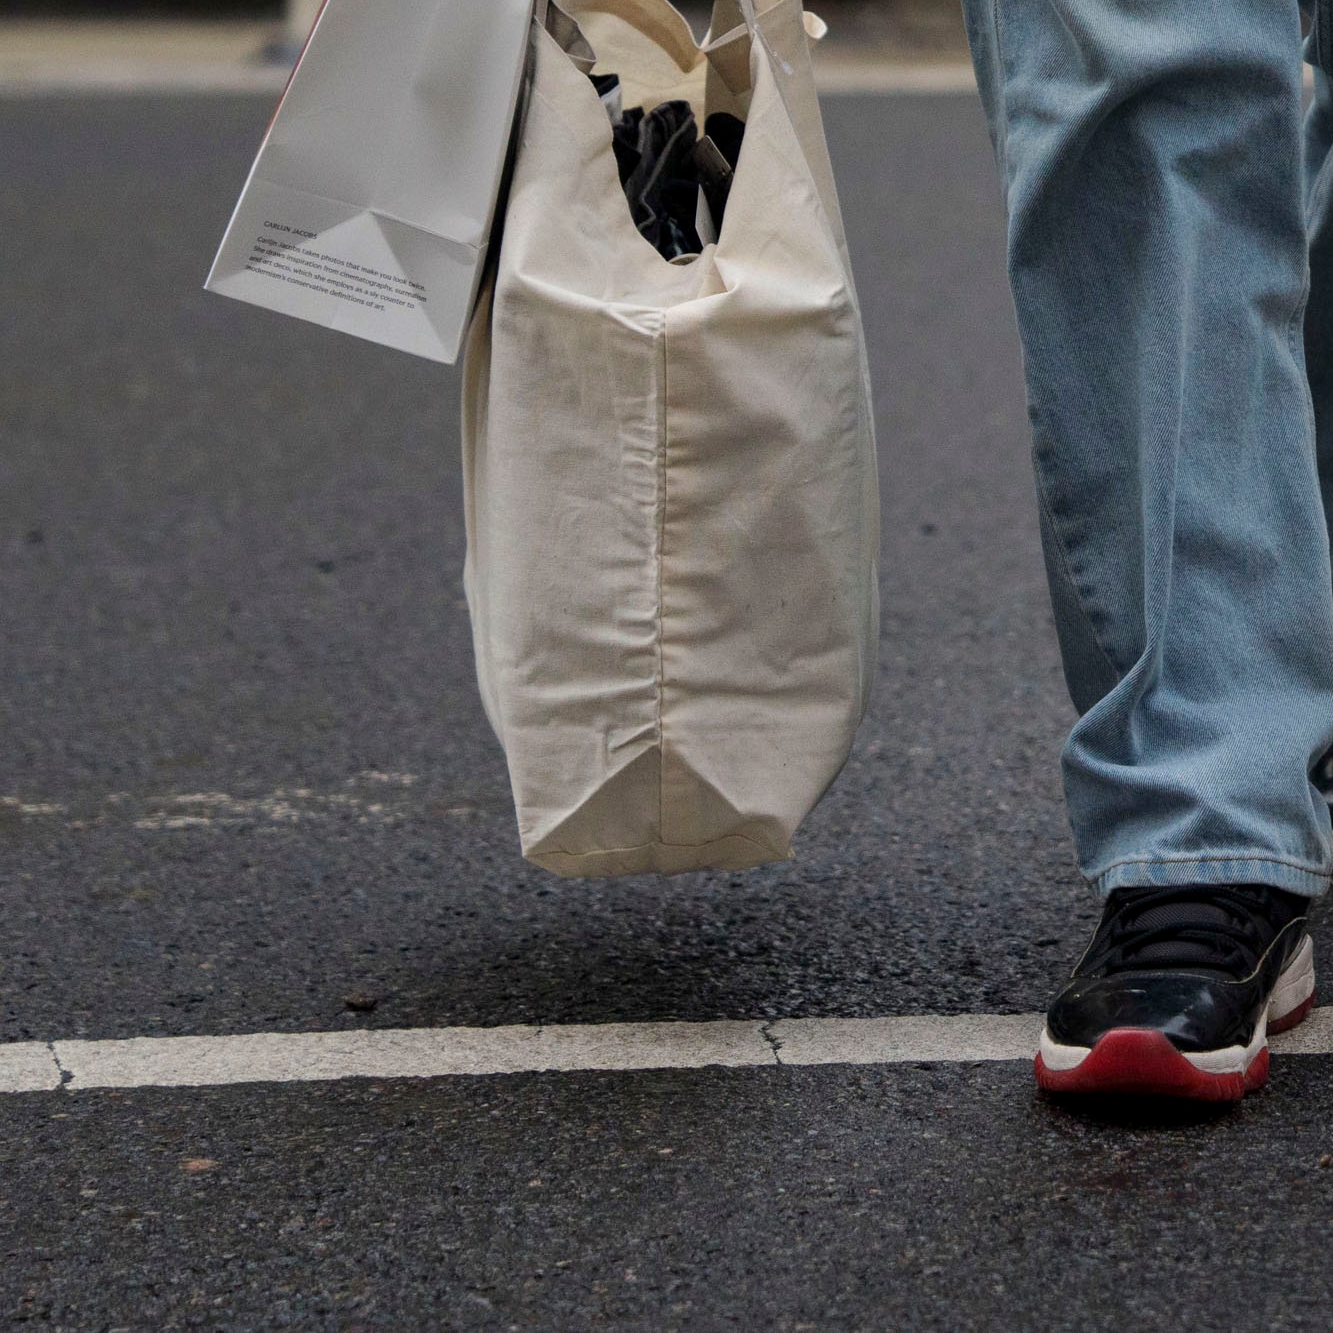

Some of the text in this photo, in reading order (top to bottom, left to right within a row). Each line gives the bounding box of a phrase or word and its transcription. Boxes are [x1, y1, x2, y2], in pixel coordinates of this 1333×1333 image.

[264, 220, 318, 240] CARLIJN JACOBS
[246, 265, 286, 281] modernism's
[287, 277, 329, 294] conservative
[330, 289, 364, 305] definitions
[253, 245, 427, 303] She draws inspiration from cinematography, surrealism
[274, 262, 291, 272] deco,
[293, 268, 313, 278] which
[314, 274, 326, 282] she
[327, 278, 354, 292] employs
[380, 294, 406, 306] counter
[279, 242, 300, 253] Jacobs
[302, 248, 320, 258] takes
[321, 254, 345, 266] photos
[346, 262, 360, 271] that
[361, 266, 379, 276] make
[380, 273, 392, 281] you
[393, 276, 407, 285] look
[408, 281, 426, 292] twice.
